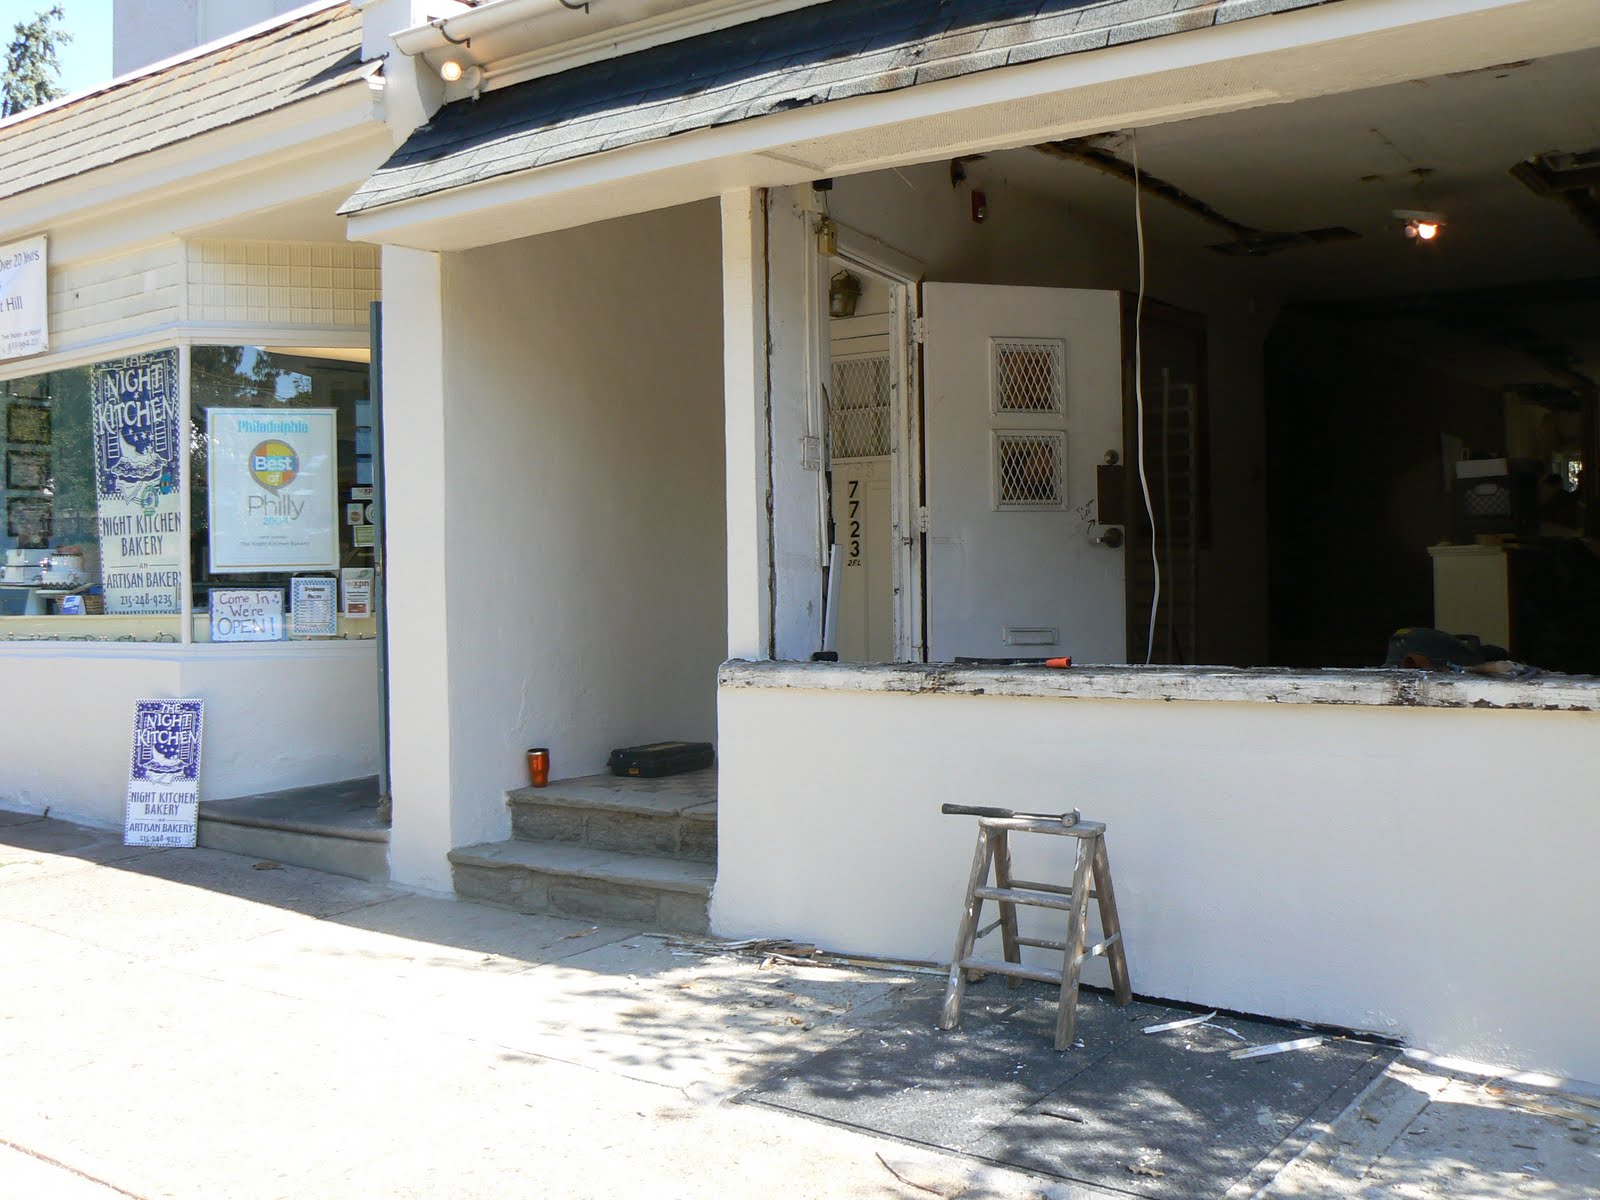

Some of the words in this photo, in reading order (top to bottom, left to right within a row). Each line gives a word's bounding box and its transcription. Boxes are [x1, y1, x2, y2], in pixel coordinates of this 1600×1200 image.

[14, 252, 22, 268] 20
[23, 249, 40, 264] Years
[6, 295, 23, 311] Hill
[106, 363, 164, 401] NIGHT
[97, 394, 175, 435] KITCHEN
[238, 420, 309, 435] Philadelphia
[255, 456, 293, 471] Best
[248, 494, 305, 521] Philly
[102, 515, 132, 536] NIGHT
[136, 512, 181, 534] KITCHEN
[848, 480, 860, 557] 7723
[122, 535, 163, 557] BAKERY
[847, 559, 861, 567] 2FL
[106, 573, 144, 589] ARTISAN
[120, 593, 172, 608] 215-248-9235
[219, 593, 249, 605] Come
[256, 594, 269, 604] In
[161, 703, 181, 714] THE
[146, 714, 193, 730] NIGHT
[135, 728, 199, 747] KITCHEN
[131, 792, 156, 803] NIGHT
[159, 792, 196, 804] KITCHEN
[144, 803, 180, 816] BAKERY
[128, 822, 160, 832] ARTISAN
[162, 823, 194, 833] BAKERY
